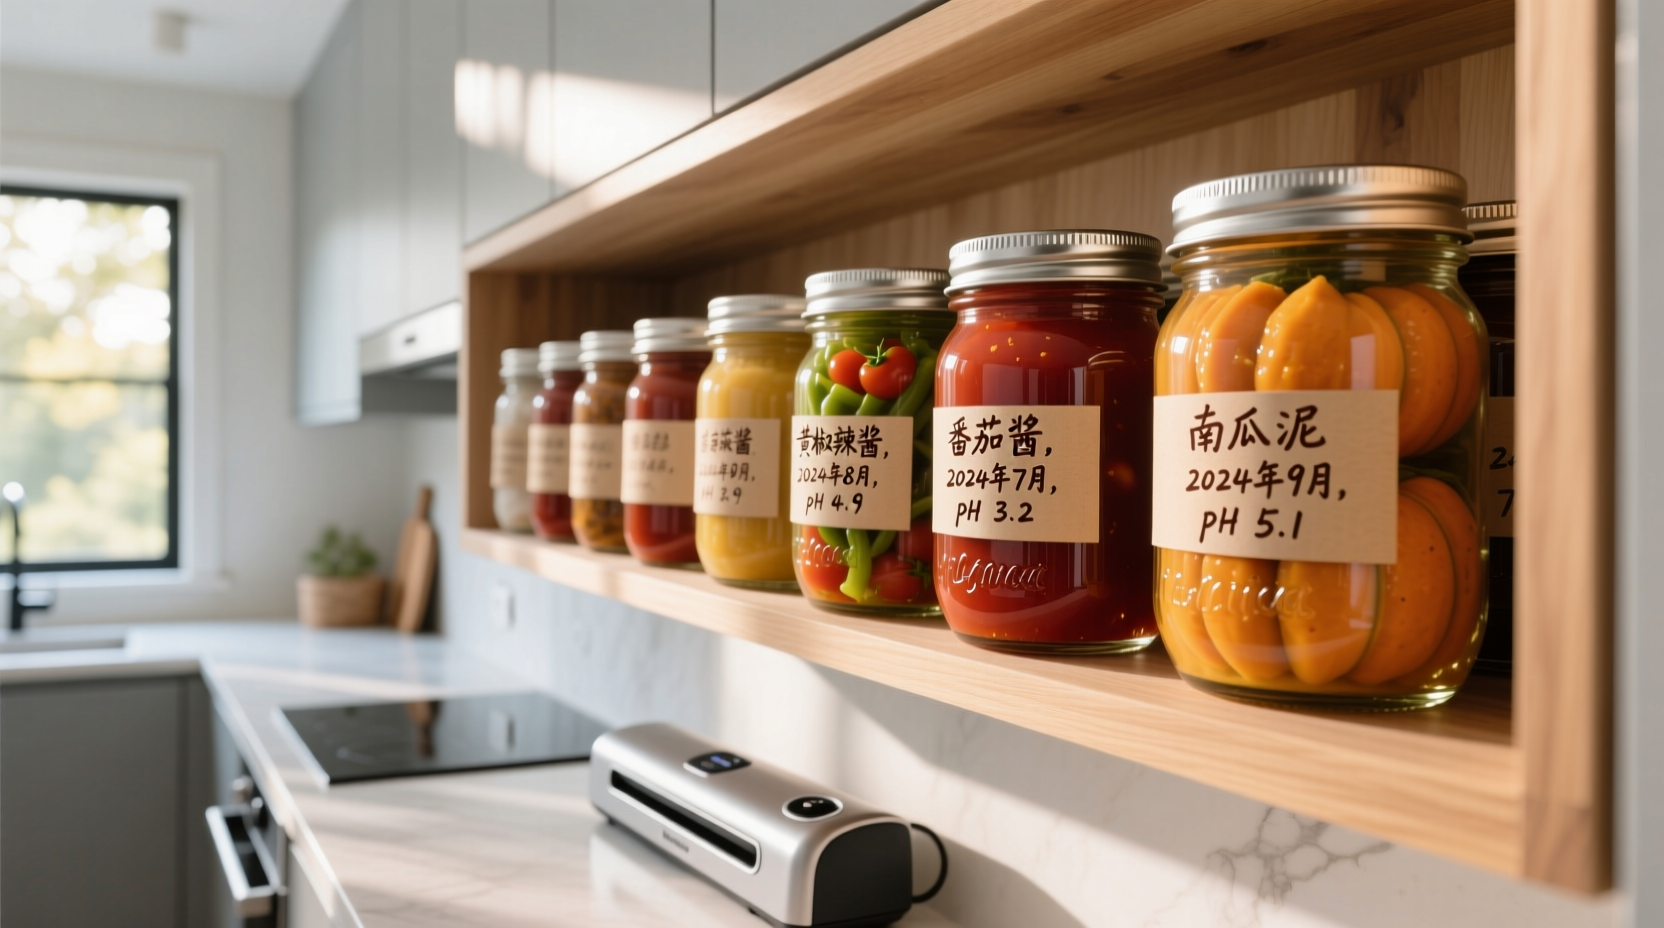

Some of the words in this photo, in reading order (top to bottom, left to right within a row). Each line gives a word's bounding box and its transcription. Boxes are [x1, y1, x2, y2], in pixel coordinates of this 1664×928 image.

[796, 424, 889, 459] 黄椒辣酱,
[947, 413, 1053, 457] 番茄酱,
[1189, 404, 1327, 453] 南瓜泥
[797, 462, 878, 488] 2024年8月,
[1489, 446, 1515, 470] 2
[946, 462, 1057, 495] 2024年7月,
[1185, 460, 1346, 501] 2024年9月,
[806, 492, 825, 516] pH
[831, 493, 864, 515] 4.9
[993, 501, 1035, 523] 3.2
[1199, 507, 1239, 543] pH
[1254, 508, 1303, 540] 5.1
